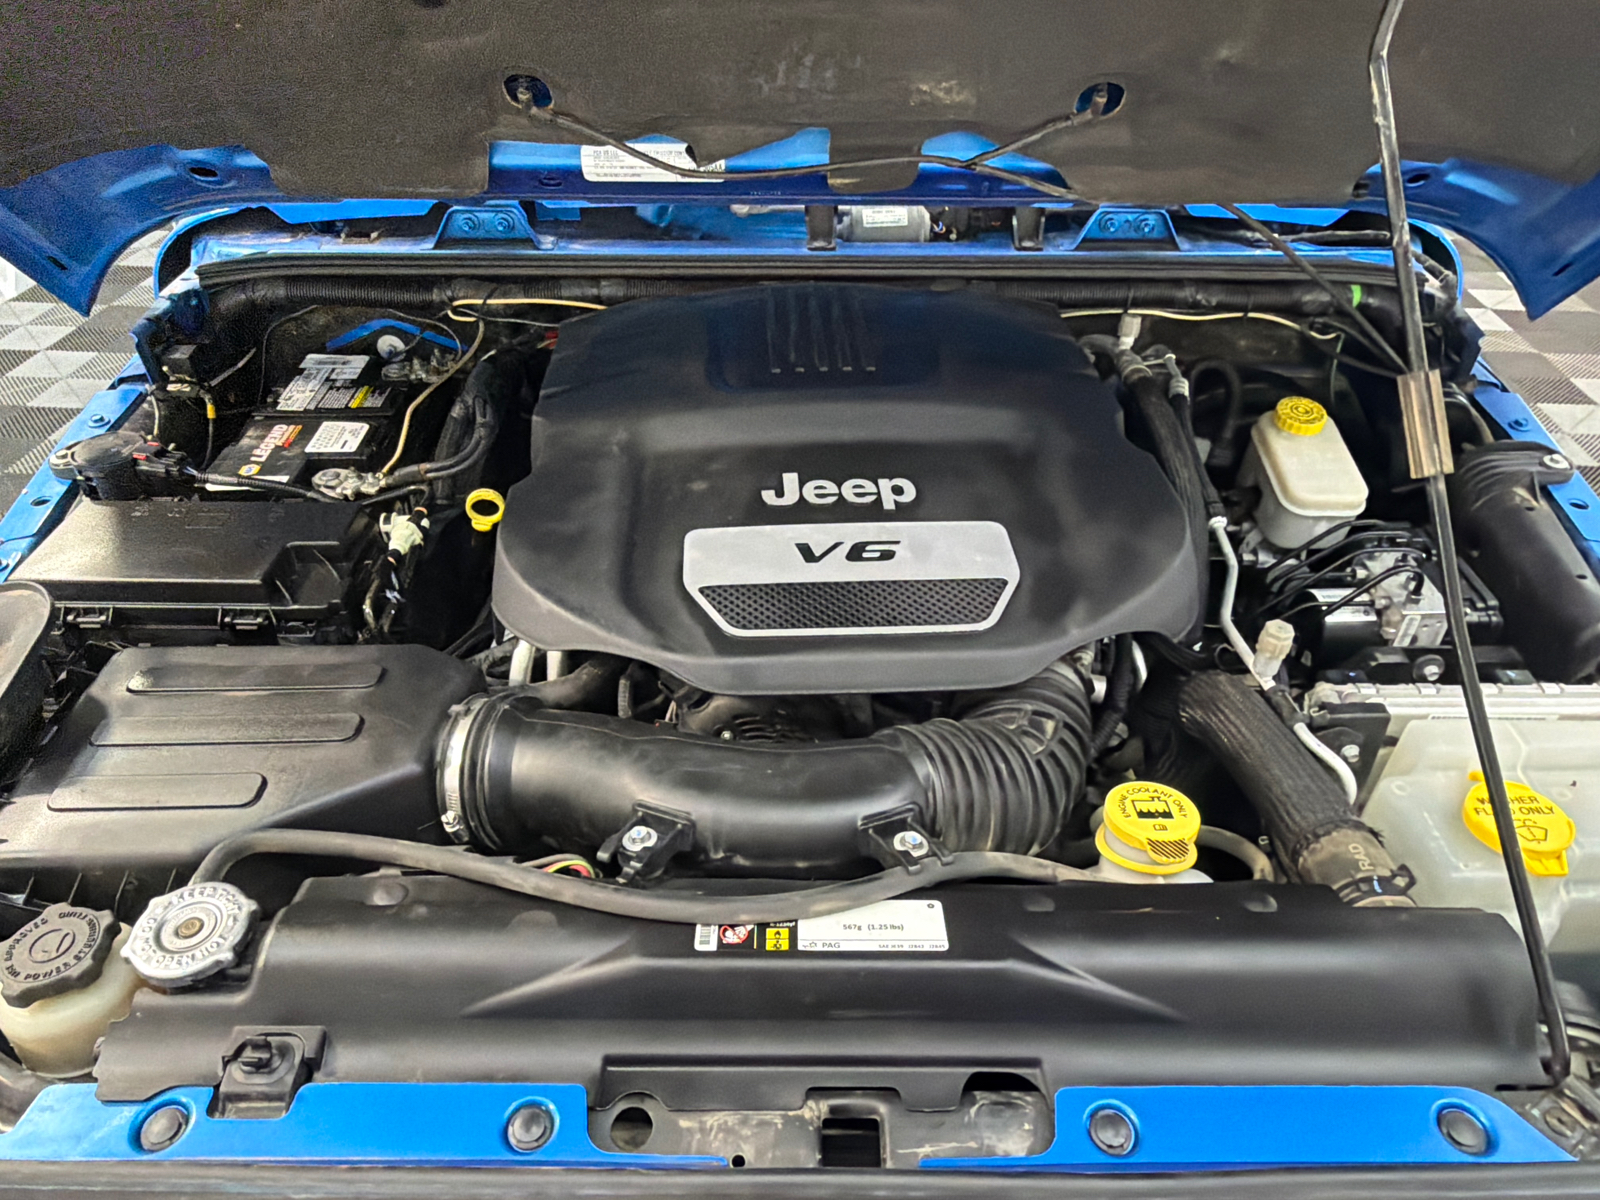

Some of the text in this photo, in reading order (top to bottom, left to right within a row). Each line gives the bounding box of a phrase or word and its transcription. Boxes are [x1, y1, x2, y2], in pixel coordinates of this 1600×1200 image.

[250, 424, 289, 462] LEGEND
[761, 472, 917, 511] Jeep
[794, 540, 901, 564] V6
[1118, 787, 1189, 819] ENGINE COOLANT ONLY
[1476, 796, 1540, 805] WHER
[1519, 805, 1555, 816] ONLY
[1348, 843, 1375, 871] RAD
